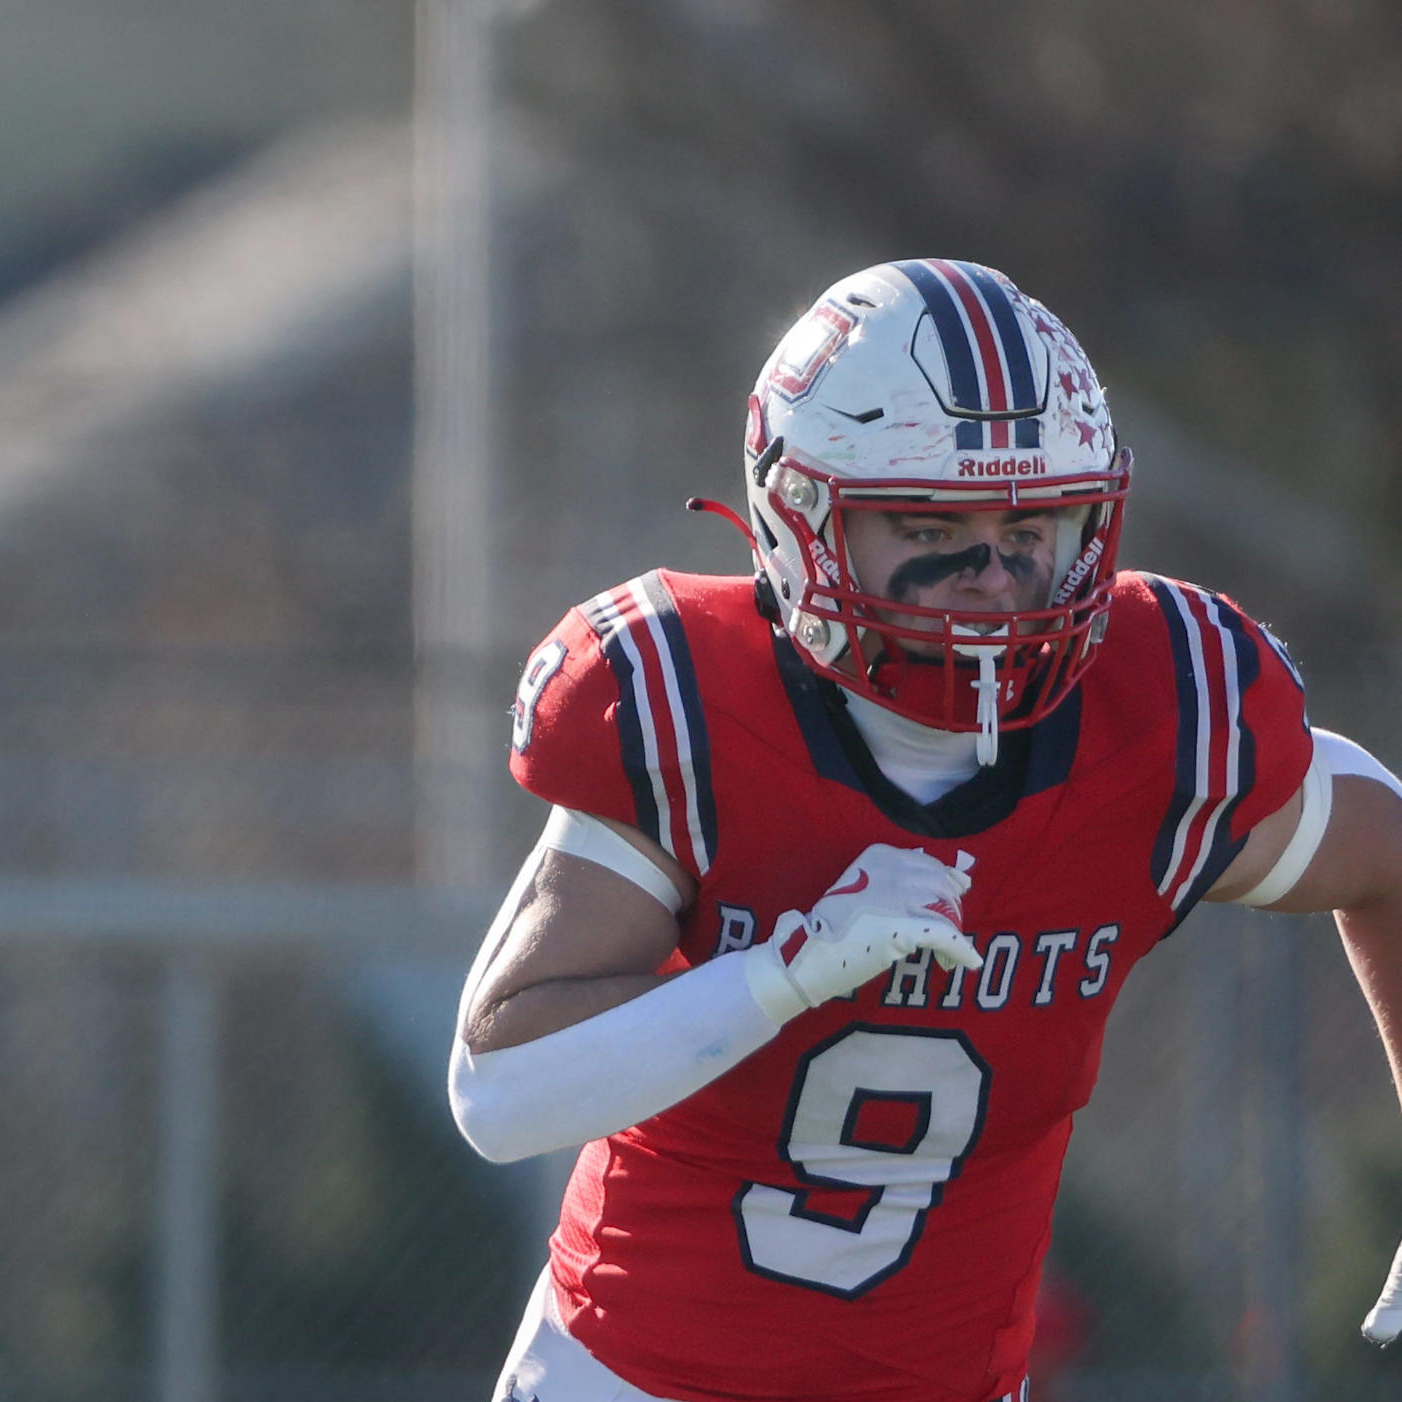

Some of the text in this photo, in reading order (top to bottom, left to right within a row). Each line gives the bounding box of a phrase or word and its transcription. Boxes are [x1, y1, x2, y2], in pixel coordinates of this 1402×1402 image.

[958, 455, 1046, 477] Riddell
[1054, 537, 1105, 605] Riddell
[712, 899, 1121, 1012] PRIOTS
[732, 1021, 992, 1301] 9
